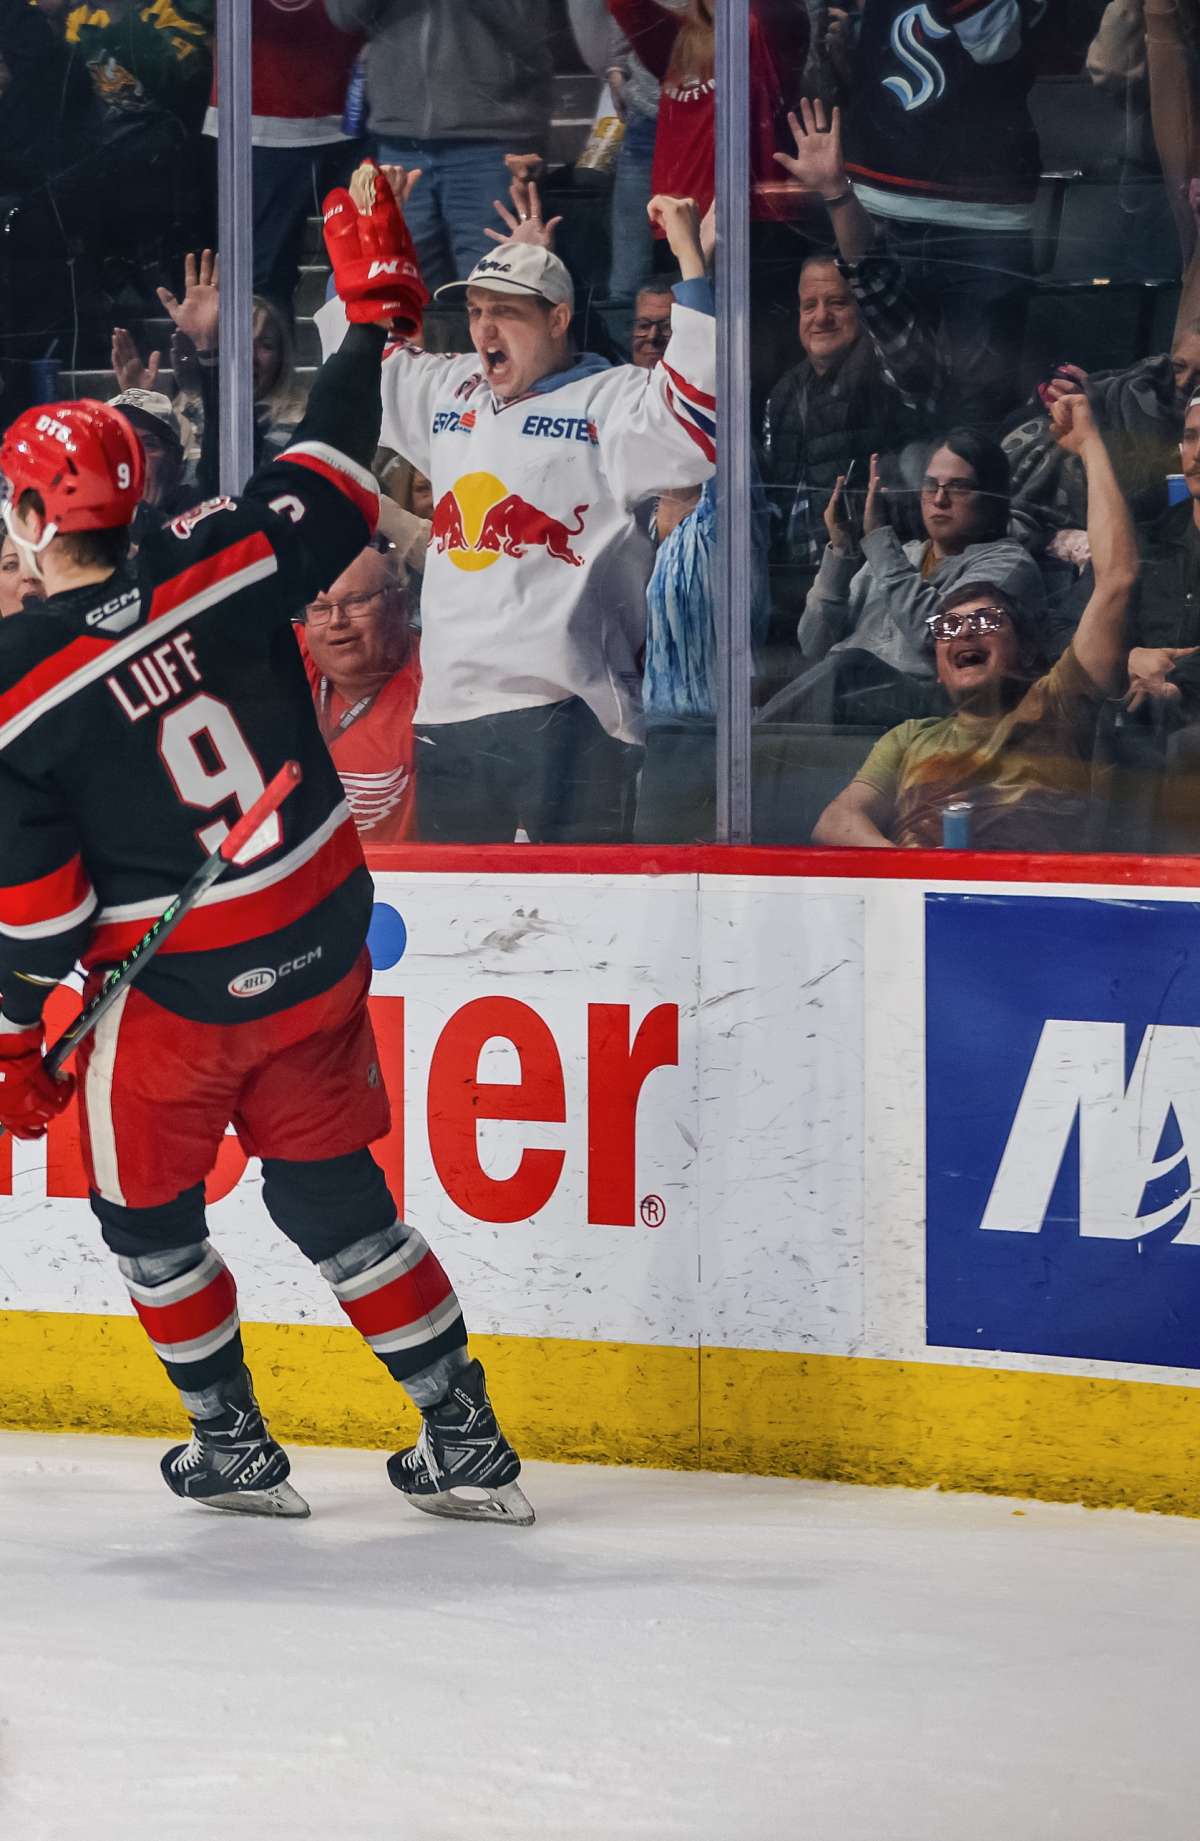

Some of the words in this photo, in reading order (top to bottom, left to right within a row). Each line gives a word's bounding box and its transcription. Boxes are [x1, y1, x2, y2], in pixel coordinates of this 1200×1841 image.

[521, 415, 590, 442] ERSTE
[116, 462, 131, 491] 9
[85, 587, 141, 626] CCM
[105, 629, 203, 722] LUFF
[157, 690, 284, 869] 9
[278, 945, 323, 977] CCM
[454, 1387, 474, 1405] CCM
